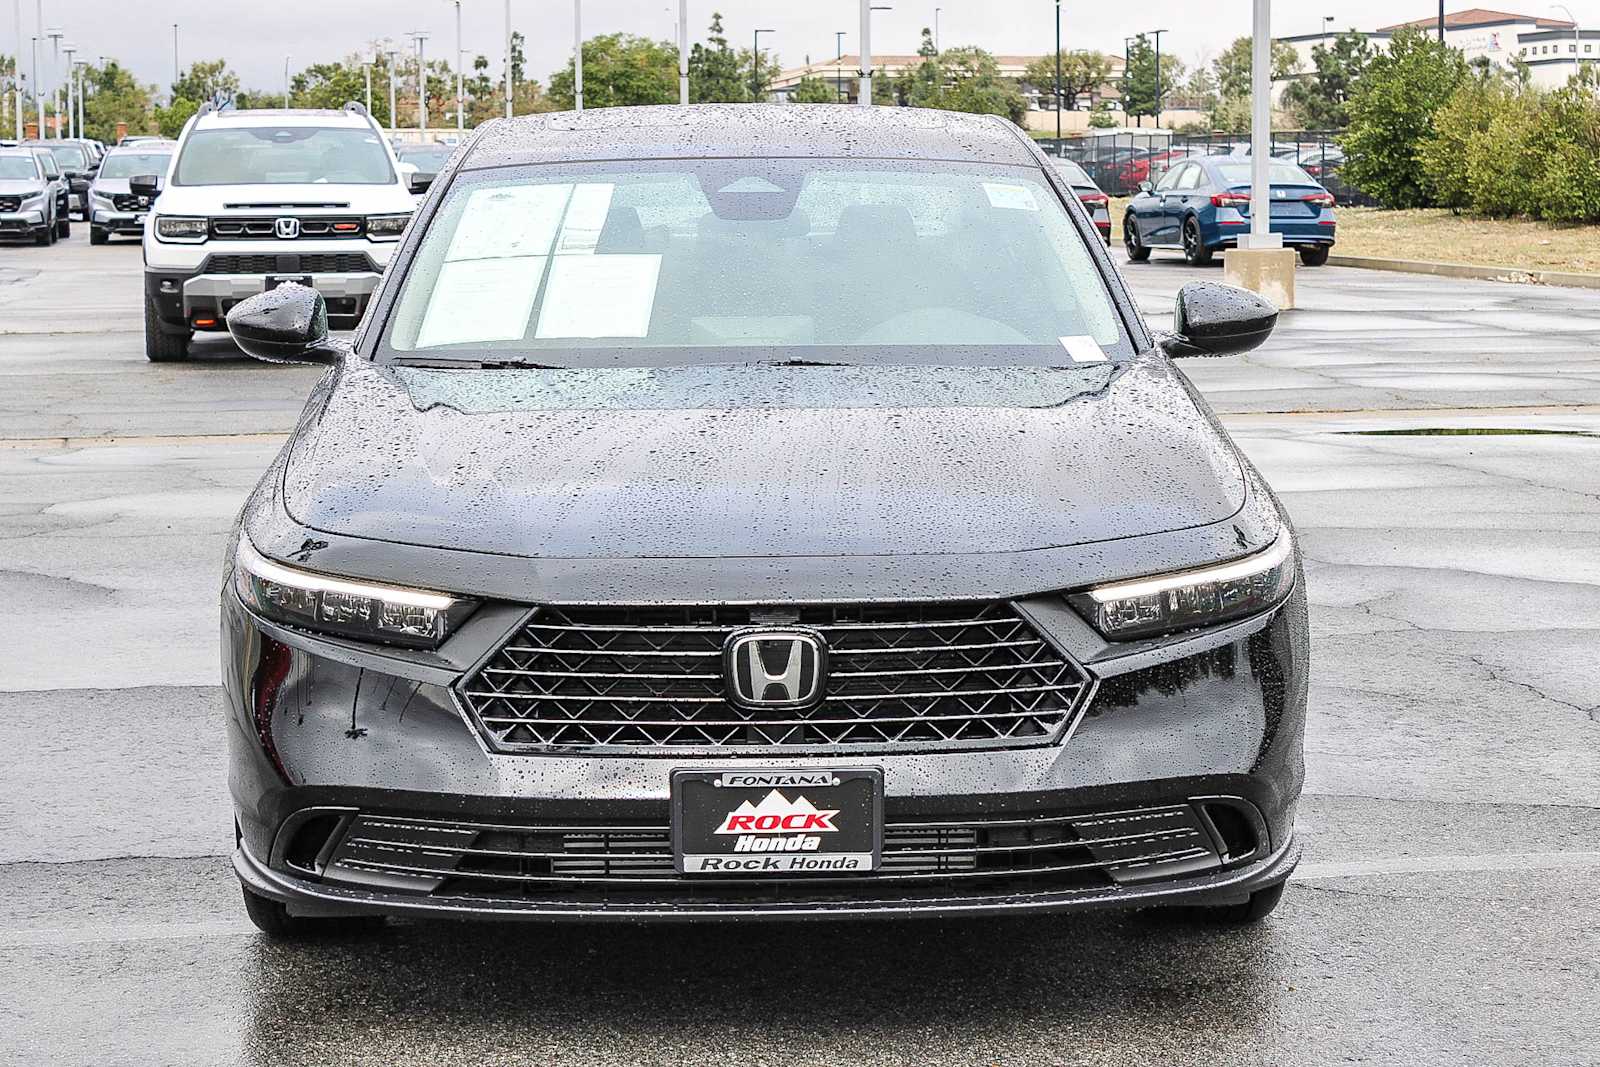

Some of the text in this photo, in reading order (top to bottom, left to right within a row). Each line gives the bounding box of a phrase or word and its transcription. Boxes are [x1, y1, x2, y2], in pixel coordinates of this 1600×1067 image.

[729, 776, 828, 785] FONTANA
[727, 814, 831, 831] ROCK
[734, 834, 822, 852] Honda
[700, 856, 859, 871] Rock Honda
